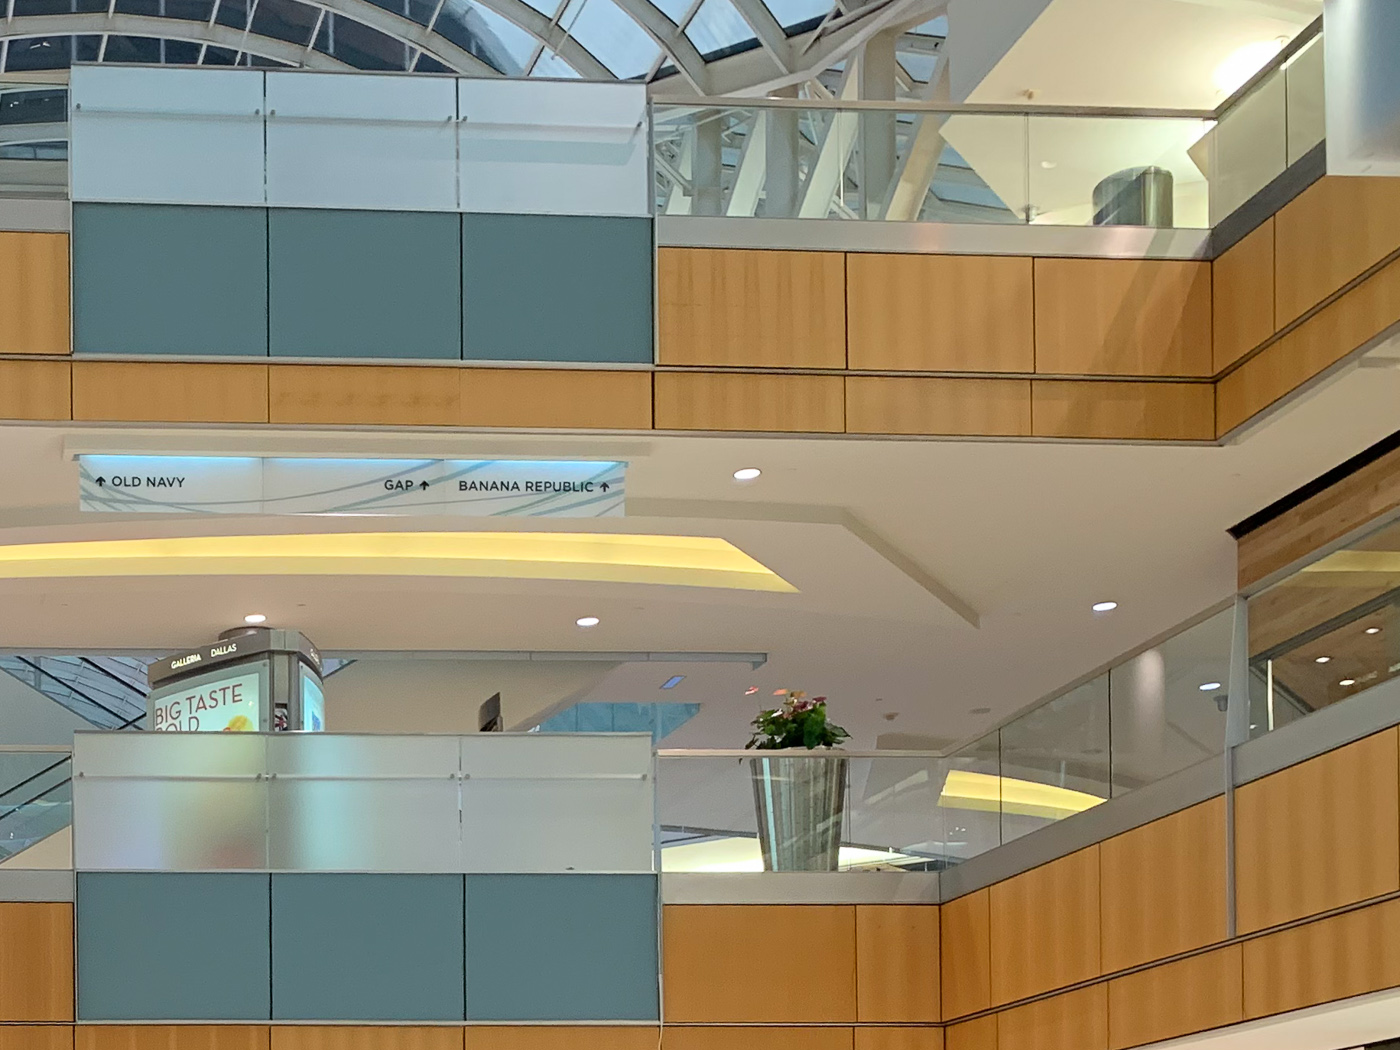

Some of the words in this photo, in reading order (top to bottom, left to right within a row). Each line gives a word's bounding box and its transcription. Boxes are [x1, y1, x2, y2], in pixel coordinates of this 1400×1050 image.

[111, 476, 142, 487] OLD
[146, 477, 185, 488] NAVY
[384, 480, 414, 491] GAP
[459, 480, 521, 492] BANANA
[525, 481, 594, 493] REPUBLIC
[170, 653, 202, 669] GALLERIA
[210, 643, 237, 657] DALLAS
[155, 701, 182, 727] BIG
[186, 683, 243, 715] TASTE
[156, 716, 200, 732] OLD
